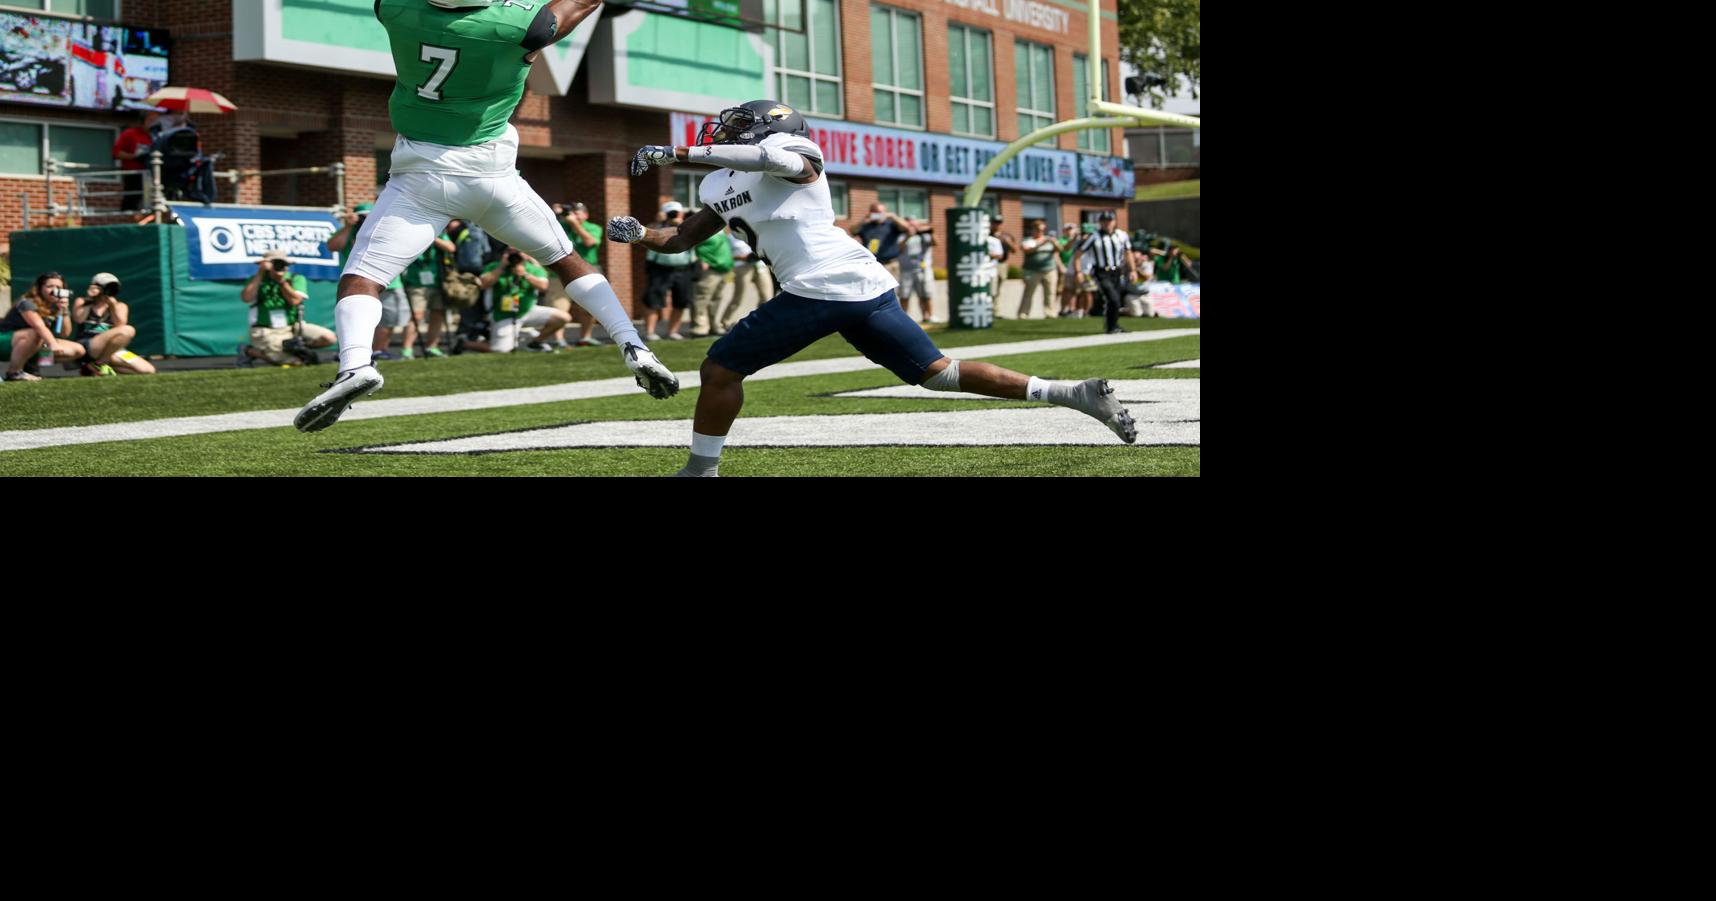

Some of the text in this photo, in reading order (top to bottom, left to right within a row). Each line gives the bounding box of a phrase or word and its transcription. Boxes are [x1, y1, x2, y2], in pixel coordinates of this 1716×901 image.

[416, 42, 460, 100] 7
[863, 133, 916, 170] SOBER
[920, 141, 940, 172] OR
[945, 145, 970, 175] GET
[1025, 154, 1055, 184] OVER
[713, 190, 752, 214] AKRON
[242, 224, 275, 240] CBS
[245, 239, 321, 256] NETWORK
